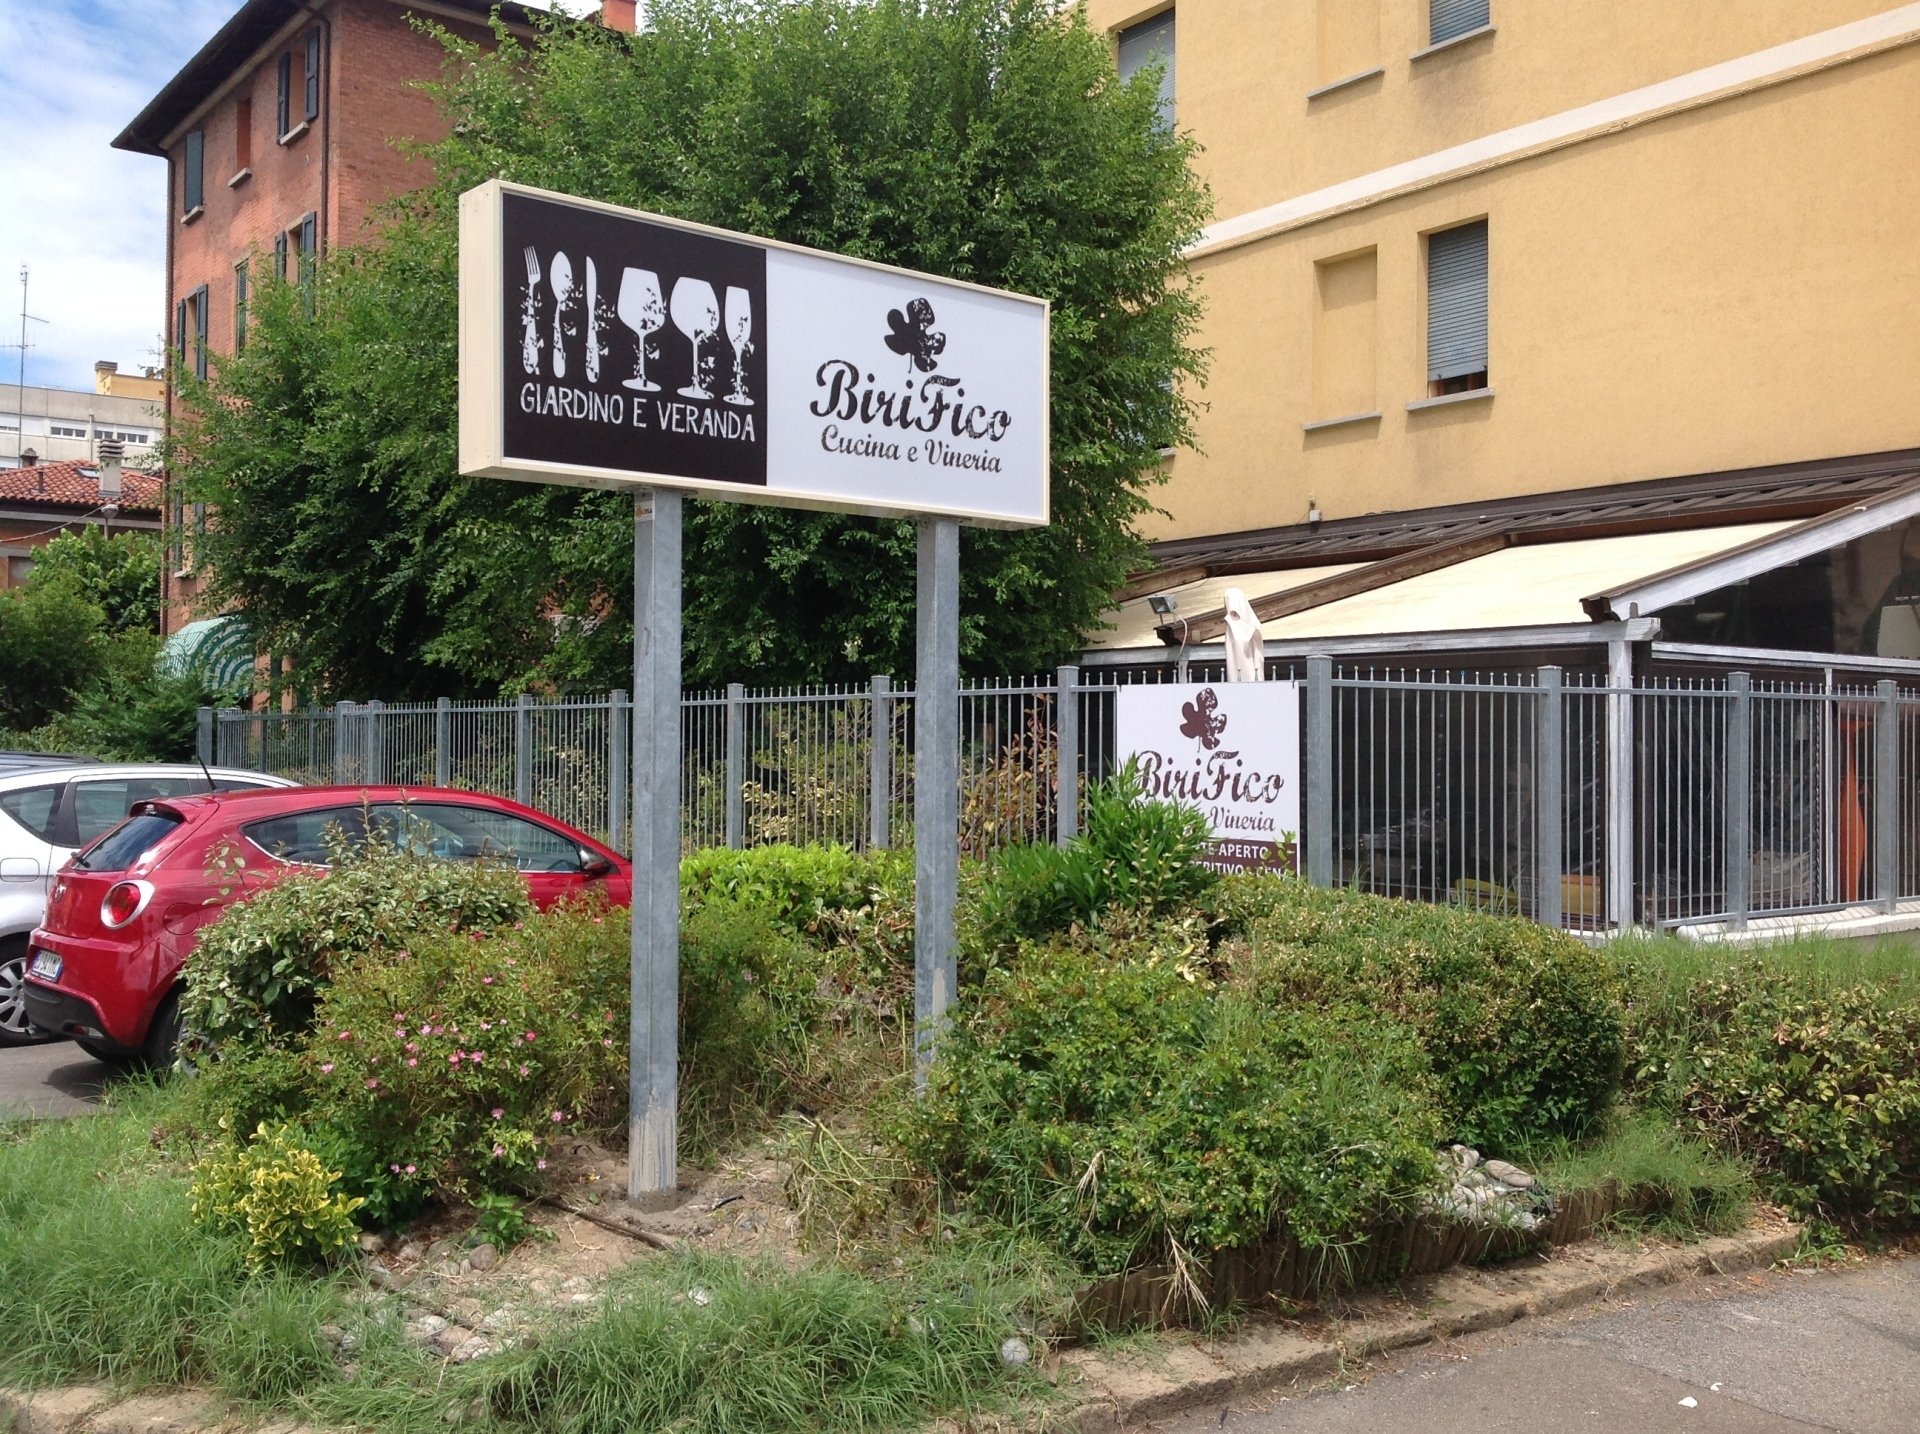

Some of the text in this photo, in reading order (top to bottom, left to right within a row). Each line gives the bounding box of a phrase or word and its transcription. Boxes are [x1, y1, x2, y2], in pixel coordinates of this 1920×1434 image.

[520, 382, 756, 443] GIARDINO E VERANDA
[809, 359, 1012, 442] BiriFico
[821, 424, 1002, 474] Cucina e Vineria
[1135, 750, 1285, 804] BiriFico
[1209, 805, 1276, 832] Vineria
[1218, 843, 1270, 860] APERTO
